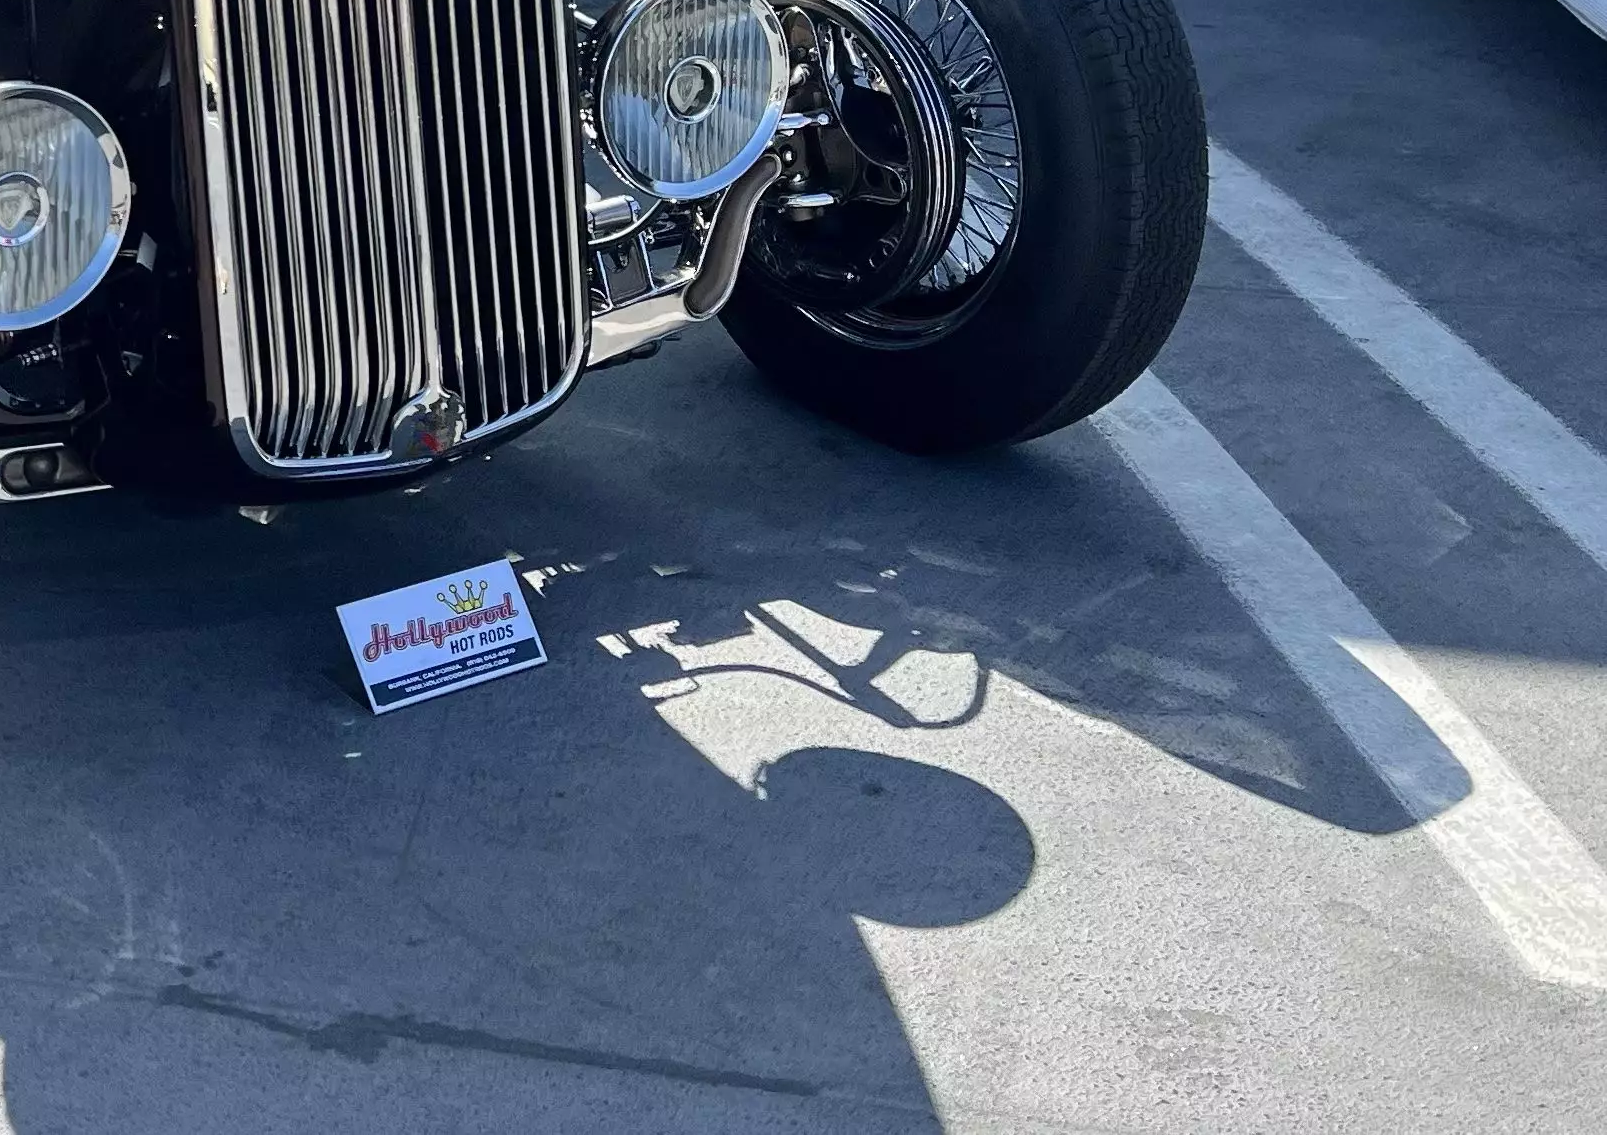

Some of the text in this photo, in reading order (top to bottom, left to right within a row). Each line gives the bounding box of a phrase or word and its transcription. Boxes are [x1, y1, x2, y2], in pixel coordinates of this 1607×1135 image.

[362, 592, 519, 662] Hollywood
[449, 624, 514, 655] HOT RODS
